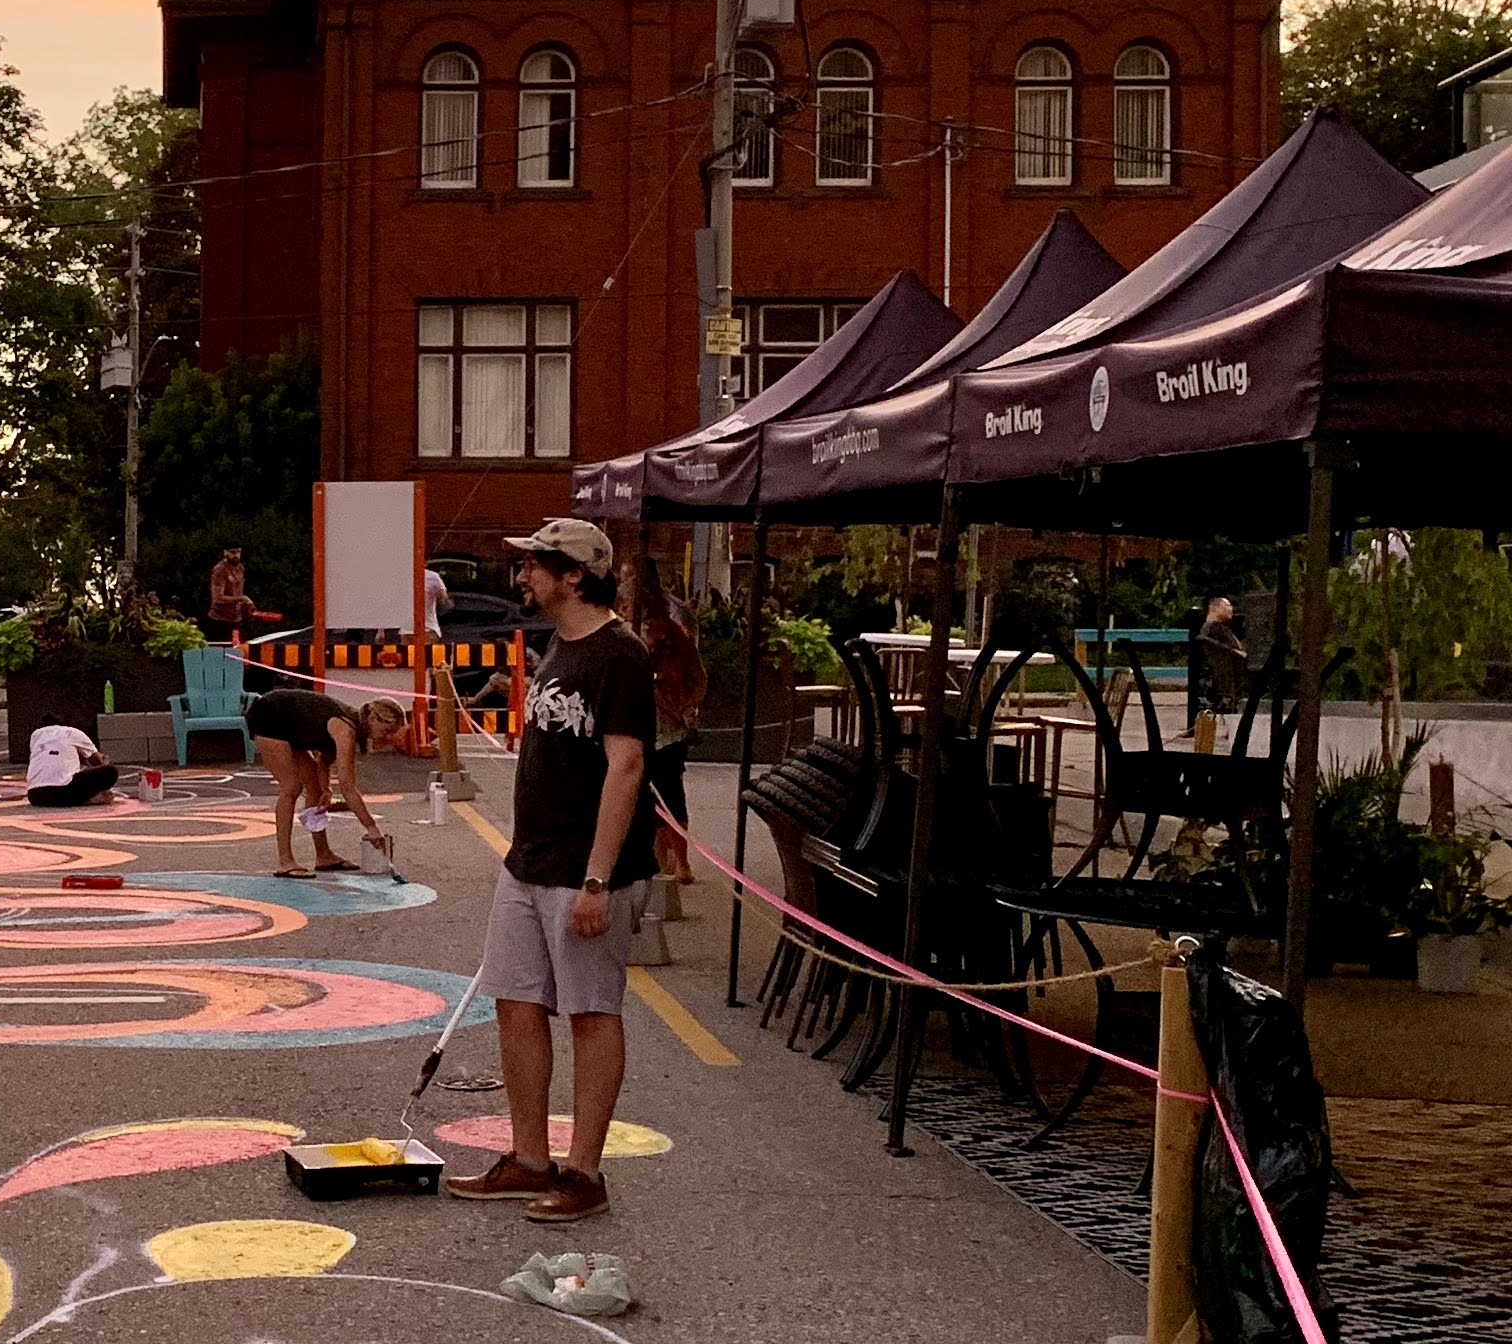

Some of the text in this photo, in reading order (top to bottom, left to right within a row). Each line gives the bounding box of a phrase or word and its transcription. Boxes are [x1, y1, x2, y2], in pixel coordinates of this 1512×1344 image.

[709, 319, 741, 333] CAUT
[1156, 362, 1200, 403] Broil
[1201, 357, 1248, 396] King
[985, 402, 1042, 438] Broil King
